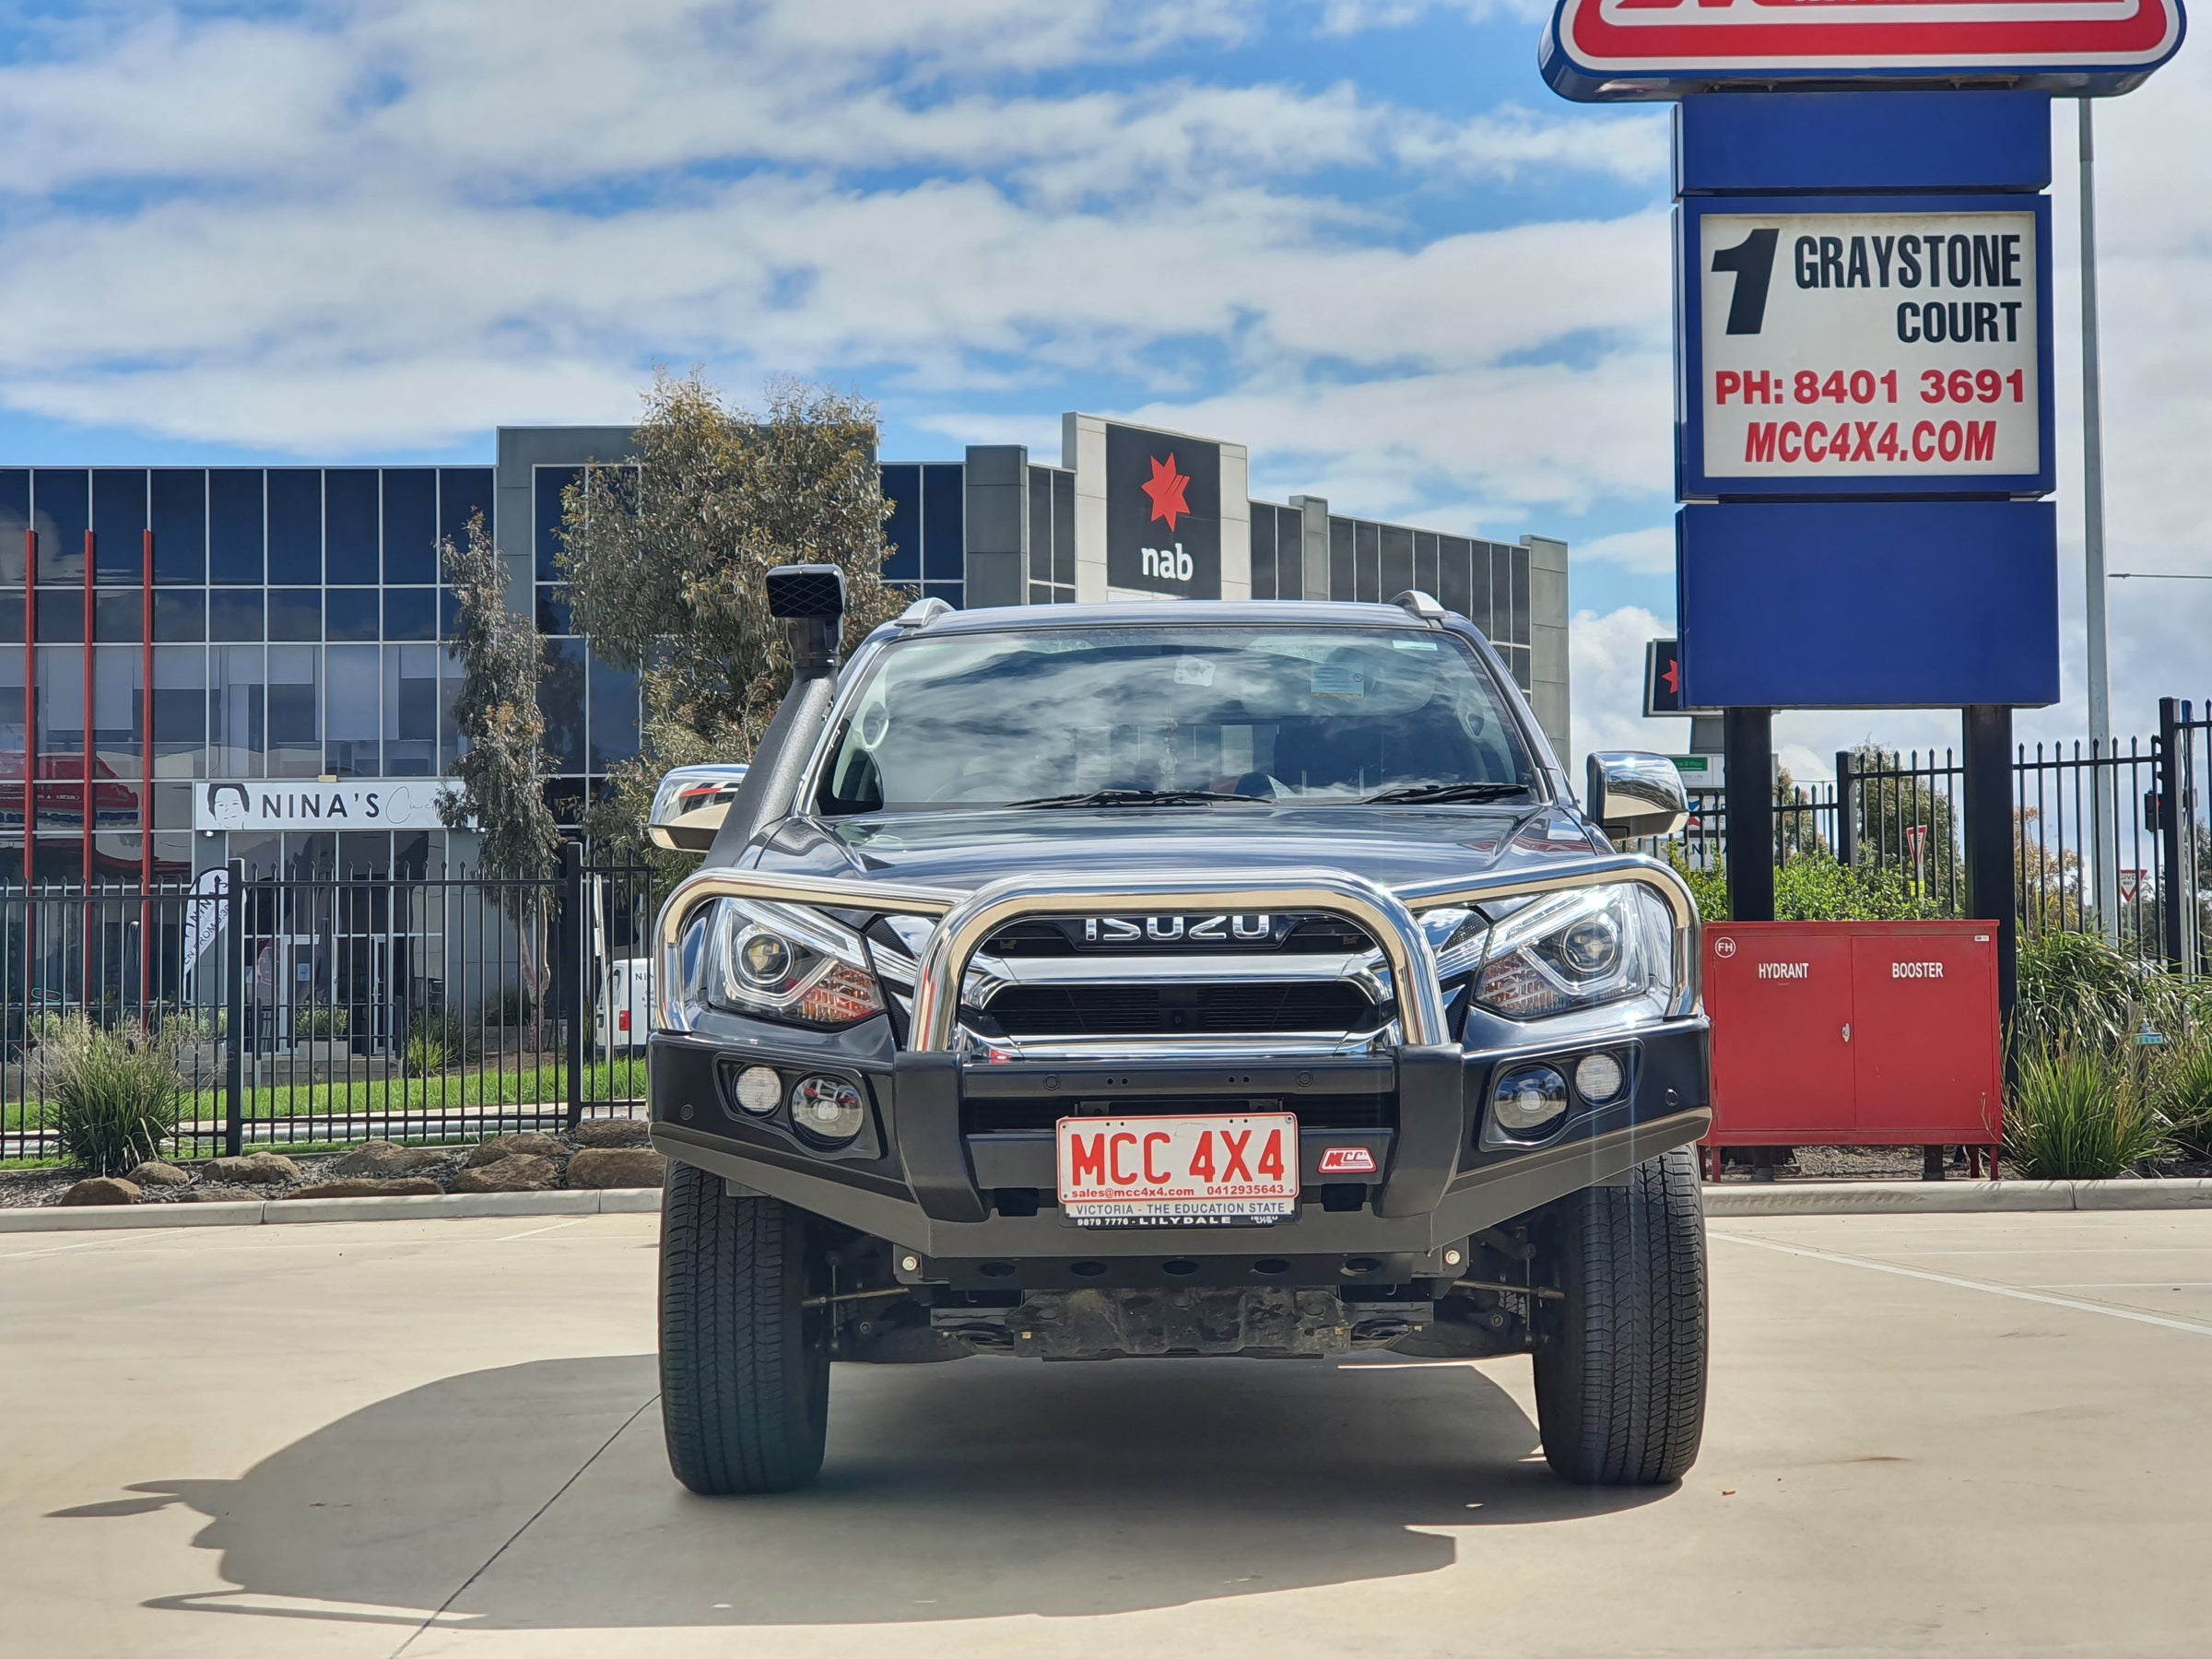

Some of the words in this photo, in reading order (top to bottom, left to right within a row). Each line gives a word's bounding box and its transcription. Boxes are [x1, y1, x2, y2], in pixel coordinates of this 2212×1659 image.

[1711, 228, 1780, 335] 1
[1794, 234, 2022, 289] GRAYSTONE
[1896, 301, 2022, 344] COURT
[1715, 371, 1783, 406] PH:
[1794, 370, 1899, 405] 8401
[1920, 368, 2025, 404] 3691
[1744, 420, 1997, 464] MCC4X4.COM
[1141, 542, 1194, 582] nab
[262, 793, 380, 818] NINA'S
[1086, 915, 1269, 940] ISUZU
[1718, 943, 1734, 952] FH
[1759, 962, 1809, 979] HYDRANT
[1892, 961, 1944, 978] BOOSTER
[1072, 1132, 1171, 1187] MCC
[1189, 1129, 1285, 1183] 4X4
[1072, 1187, 1194, 1198] sales@mcc4x4.com
[1206, 1184, 1284, 1195] 0412935643
[1077, 1204, 1134, 1215] VICTORIA
[1147, 1204, 1171, 1214] THE
[1174, 1202, 1244, 1214] EDUCATION
[1249, 1202, 1285, 1212] STATE
[1139, 1217, 1230, 1225] LILYDALE
